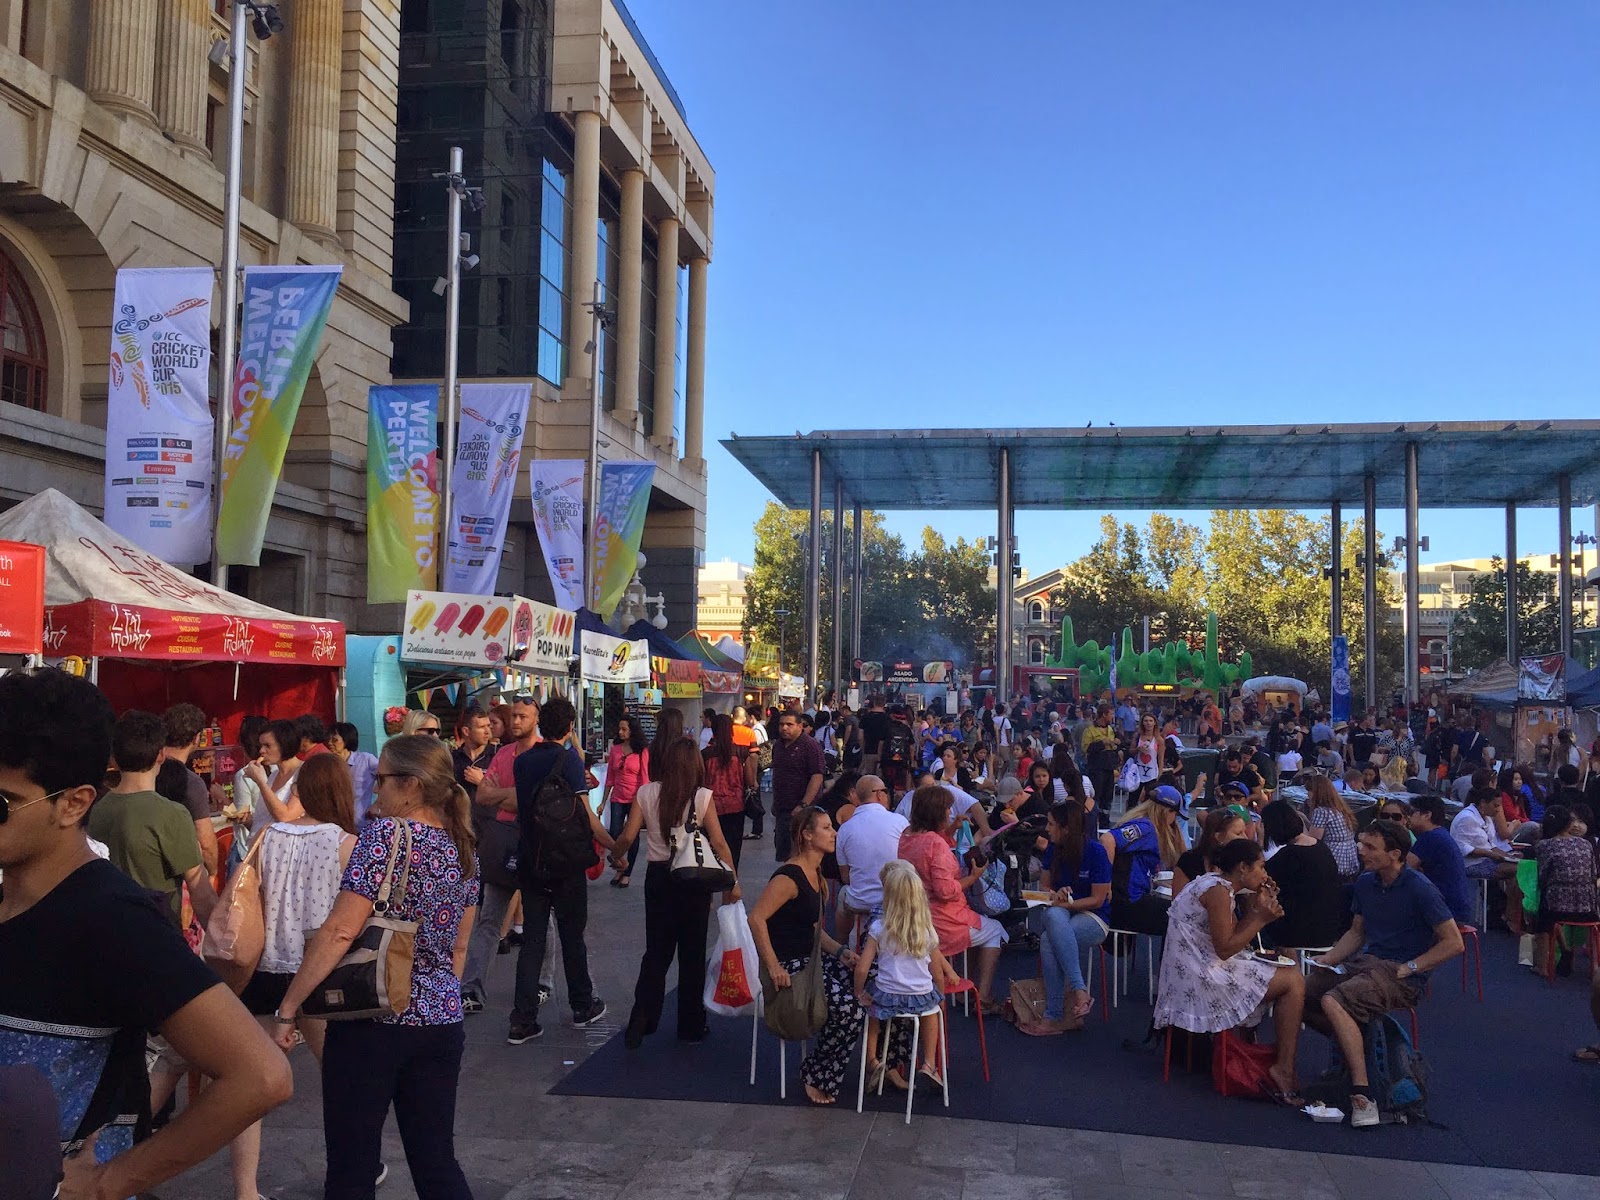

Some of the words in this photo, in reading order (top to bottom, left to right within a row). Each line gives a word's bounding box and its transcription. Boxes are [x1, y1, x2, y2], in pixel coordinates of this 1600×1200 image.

[164, 332, 182, 341] ICC
[152, 342, 206, 358] CRICKET
[152, 355, 199, 369] WORLD
[153, 368, 175, 382] CUP
[154, 381, 182, 395] 2015
[387, 401, 407, 483] PERTH
[146, 465, 175, 473] Emirates
[408, 400, 434, 525] WELCOME
[553, 502, 580, 510] CRICKET
[553, 509, 578, 517] WORLD
[553, 516, 566, 524] CUP
[415, 534, 433, 568] TO
[168, 645, 203, 654] RESTAURANT
[407, 642, 433, 654] Delicious
[434, 648, 455, 656] artisan
[455, 649, 463, 657] ice
[537, 639, 553, 657] POP
[554, 642, 570, 660] VAN
